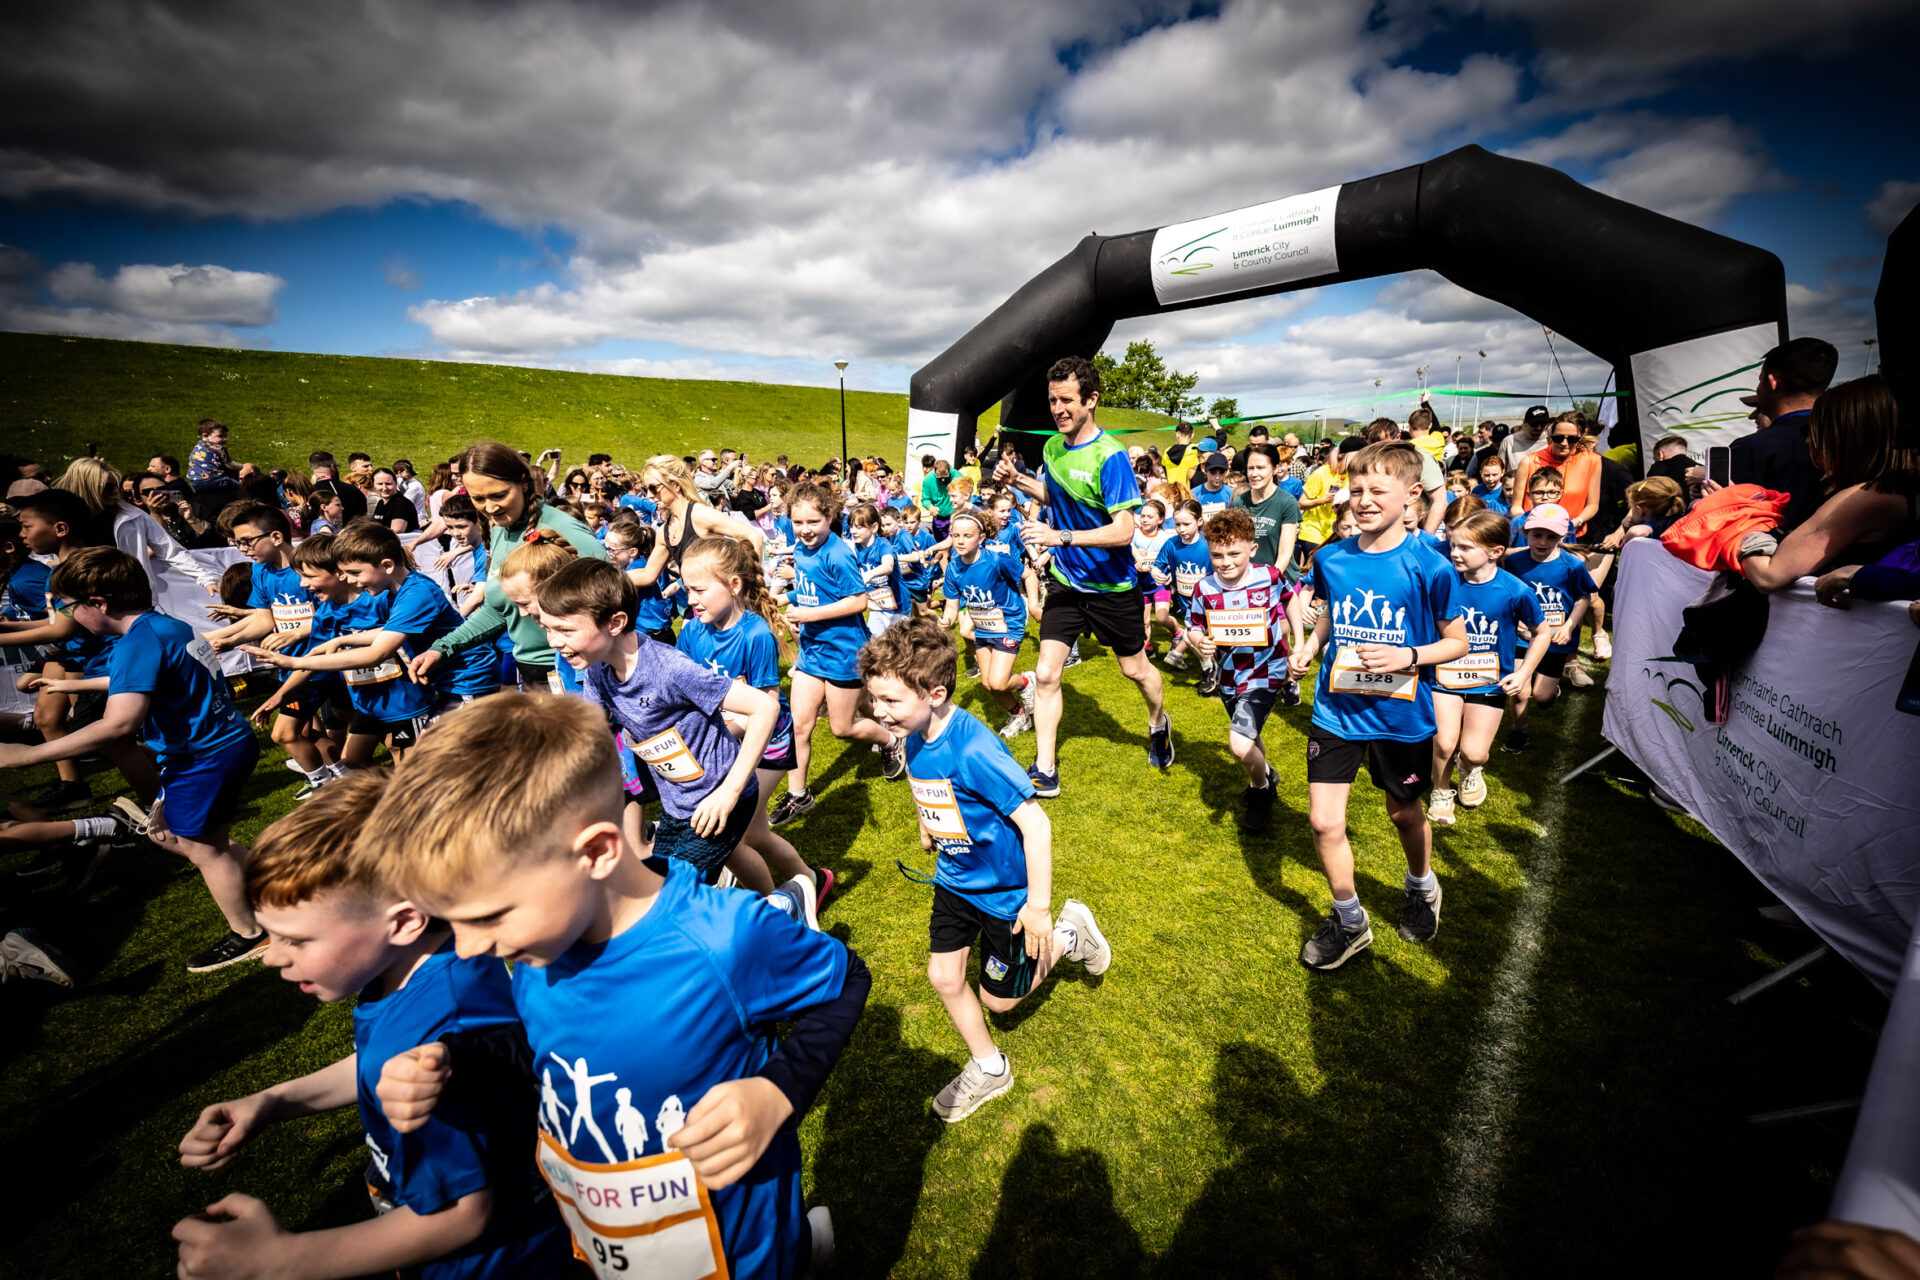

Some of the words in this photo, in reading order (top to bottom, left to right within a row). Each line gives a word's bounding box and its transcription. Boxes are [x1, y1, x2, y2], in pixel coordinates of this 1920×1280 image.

[1273, 214, 1319, 232] Luimnigh
[1232, 244, 1271, 260] Limerick
[1272, 240, 1290, 251] City
[1233, 260, 1240, 270] &
[1241, 254, 1273, 268] County
[1274, 245, 1310, 261] Council
[294, 607, 311, 615] FUN
[1227, 613, 1244, 621] FOR
[1224, 628, 1251, 636] 1935
[1354, 629, 1377, 641] FOR
[1378, 632, 1404, 642] FUN
[1467, 635, 1478, 643] OR
[1477, 657, 1495, 665] FUN
[1355, 673, 1393, 683] 1528
[1779, 694, 1843, 746] Cathrach
[1733, 692, 1766, 728] Contae
[1766, 714, 1837, 773] Luimnigh
[638, 748, 654, 757] OR
[653, 738, 677, 753] FUN
[1717, 727, 1756, 773] Limerick
[1756, 761, 1782, 794] City
[926, 788, 948, 798] FUN
[1753, 786, 1805, 839] Council
[575, 1181, 622, 1209] FOR
[630, 1176, 689, 1207] FUN
[592, 1236, 629, 1272] 95
